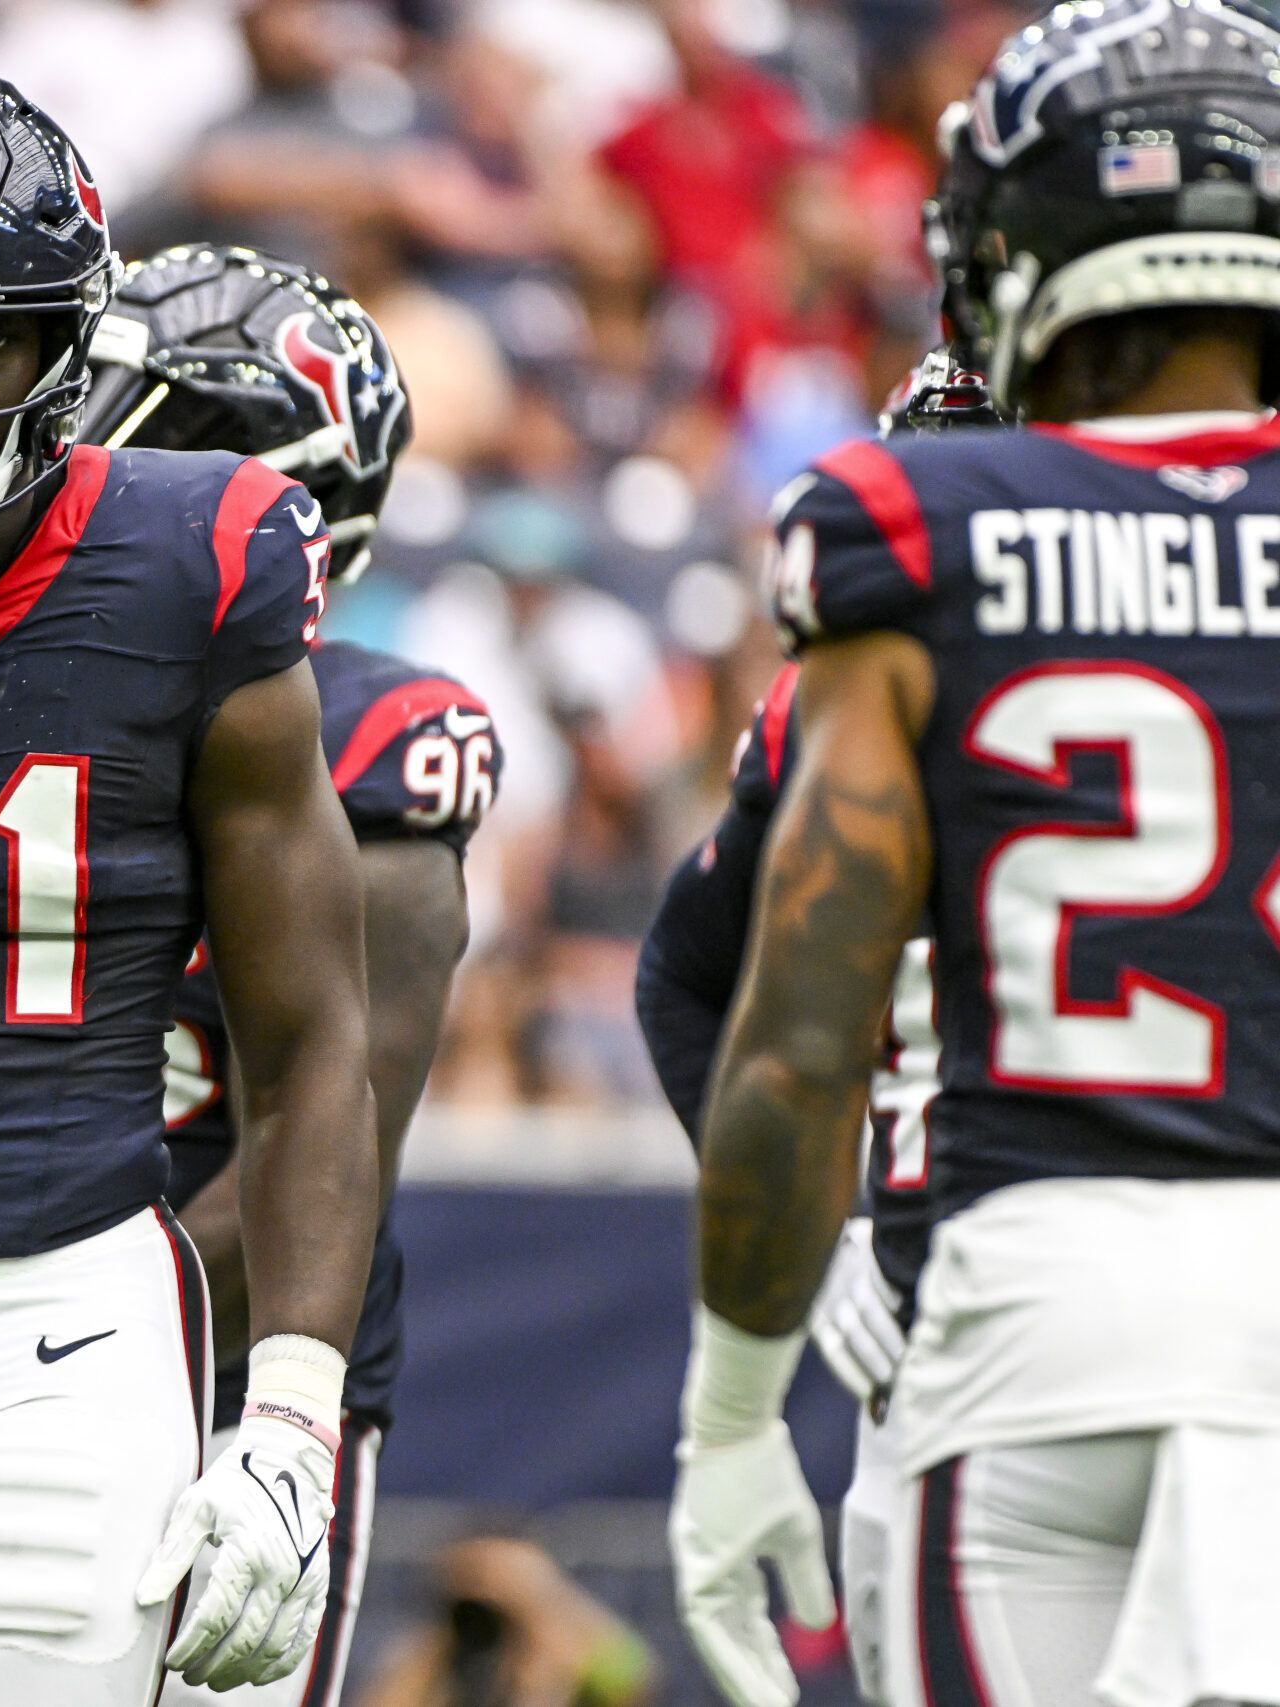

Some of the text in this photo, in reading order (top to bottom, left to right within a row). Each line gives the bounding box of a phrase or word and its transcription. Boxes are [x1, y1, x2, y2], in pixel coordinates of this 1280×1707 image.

[969, 507, 1280, 637] STINGLE
[402, 732, 494, 831] 96
[960, 658, 1280, 1099] 2
